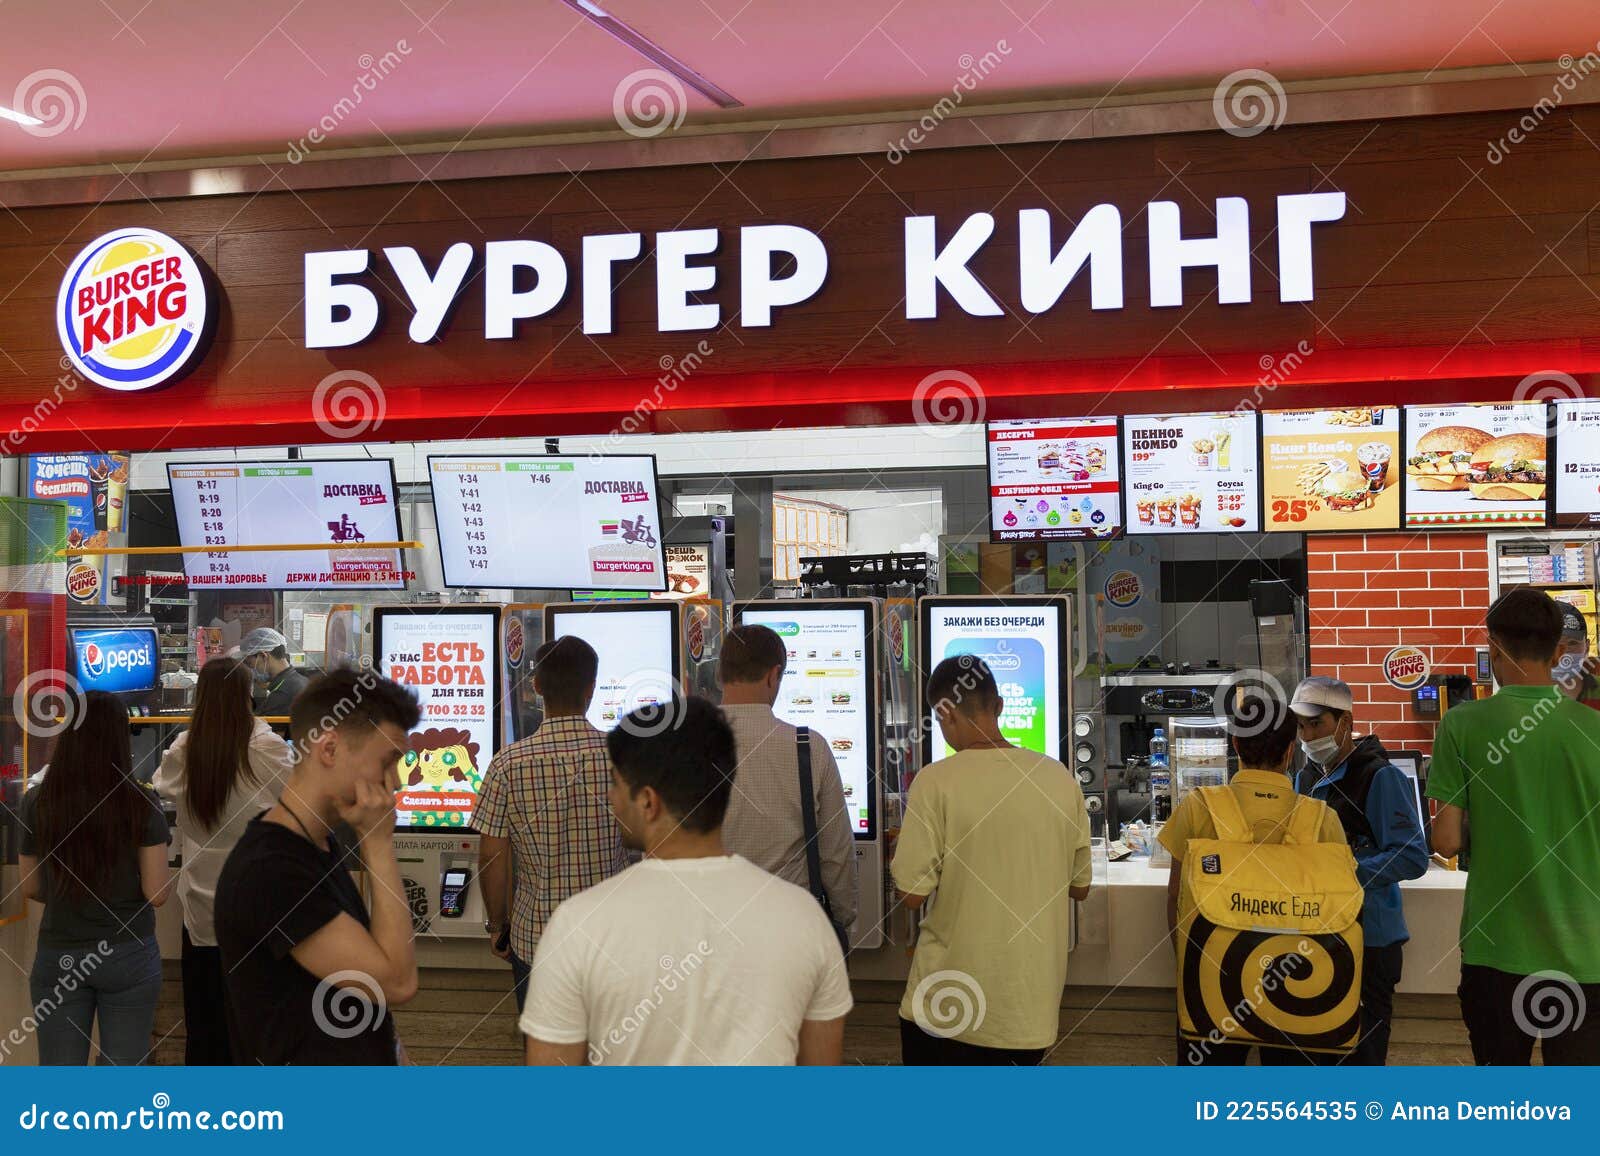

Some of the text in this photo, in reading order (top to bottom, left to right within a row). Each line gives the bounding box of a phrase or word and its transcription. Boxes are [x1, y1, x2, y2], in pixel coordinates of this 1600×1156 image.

[304, 192, 1346, 349] БУРГЕР КИНГ
[78, 256, 182, 316] BURGER
[83, 282, 187, 354] KING
[996, 431, 1034, 440] ДЕСЕРТЫ
[1131, 428, 1184, 439] ПЕННОЕ
[1131, 439, 1178, 450] КОМБО
[1565, 463, 1578, 473] 12
[458, 474, 478, 483] Y-34
[530, 474, 551, 483] Y-46
[197, 480, 217, 490] R-17
[584, 481, 645, 494] ДОСТАВКА
[1133, 482, 1153, 490] King
[323, 484, 383, 498] ДОСТАВКА
[460, 488, 480, 498] Y-41
[199, 494, 219, 504] R-19
[462, 503, 482, 512] Y-42
[1271, 500, 1321, 522] 25%
[201, 508, 222, 518] R-20
[204, 522, 224, 531] E-18
[464, 517, 484, 527] Y-43
[206, 535, 226, 545] R-23
[466, 531, 486, 541] Y-45
[467, 545, 488, 555] Y-33
[210, 563, 230, 572] R-24
[335, 563, 390, 572] burgerking.ru
[469, 559, 489, 569] Y-47
[595, 561, 652, 572] burgerking.ru
[69, 570, 96, 584] BURGER
[192, 575, 223, 584] ВАШЕМ
[225, 574, 267, 584] ЗДОРОВЬЕ
[286, 573, 317, 582] ДЕРЖИ
[319, 572, 371, 583] ДИСТАНЦИЮ
[373, 572, 386, 582] 1,5
[71, 576, 97, 593] KING
[1108, 576, 1138, 590] BURGER
[1110, 583, 1139, 600] KING
[943, 617, 1045, 627] ЗАКАЖИ БЕЗ ОЧЕРЕДИ
[399, 653, 421, 662] НАС
[422, 641, 485, 663] ЕСТЬ
[107, 644, 149, 674] pepsi
[1389, 655, 1423, 669] BURGER
[390, 665, 485, 685] РАБОТА
[1390, 662, 1424, 679] KING
[431, 688, 484, 697] ДЛЯ ТЕБЯ
[426, 704, 485, 715] 700 32 32
[402, 796, 471, 806] Сделать заказ
[421, 840, 455, 850] КАРТОЙ
[1230, 892, 1320, 919] Яндекс Еда
